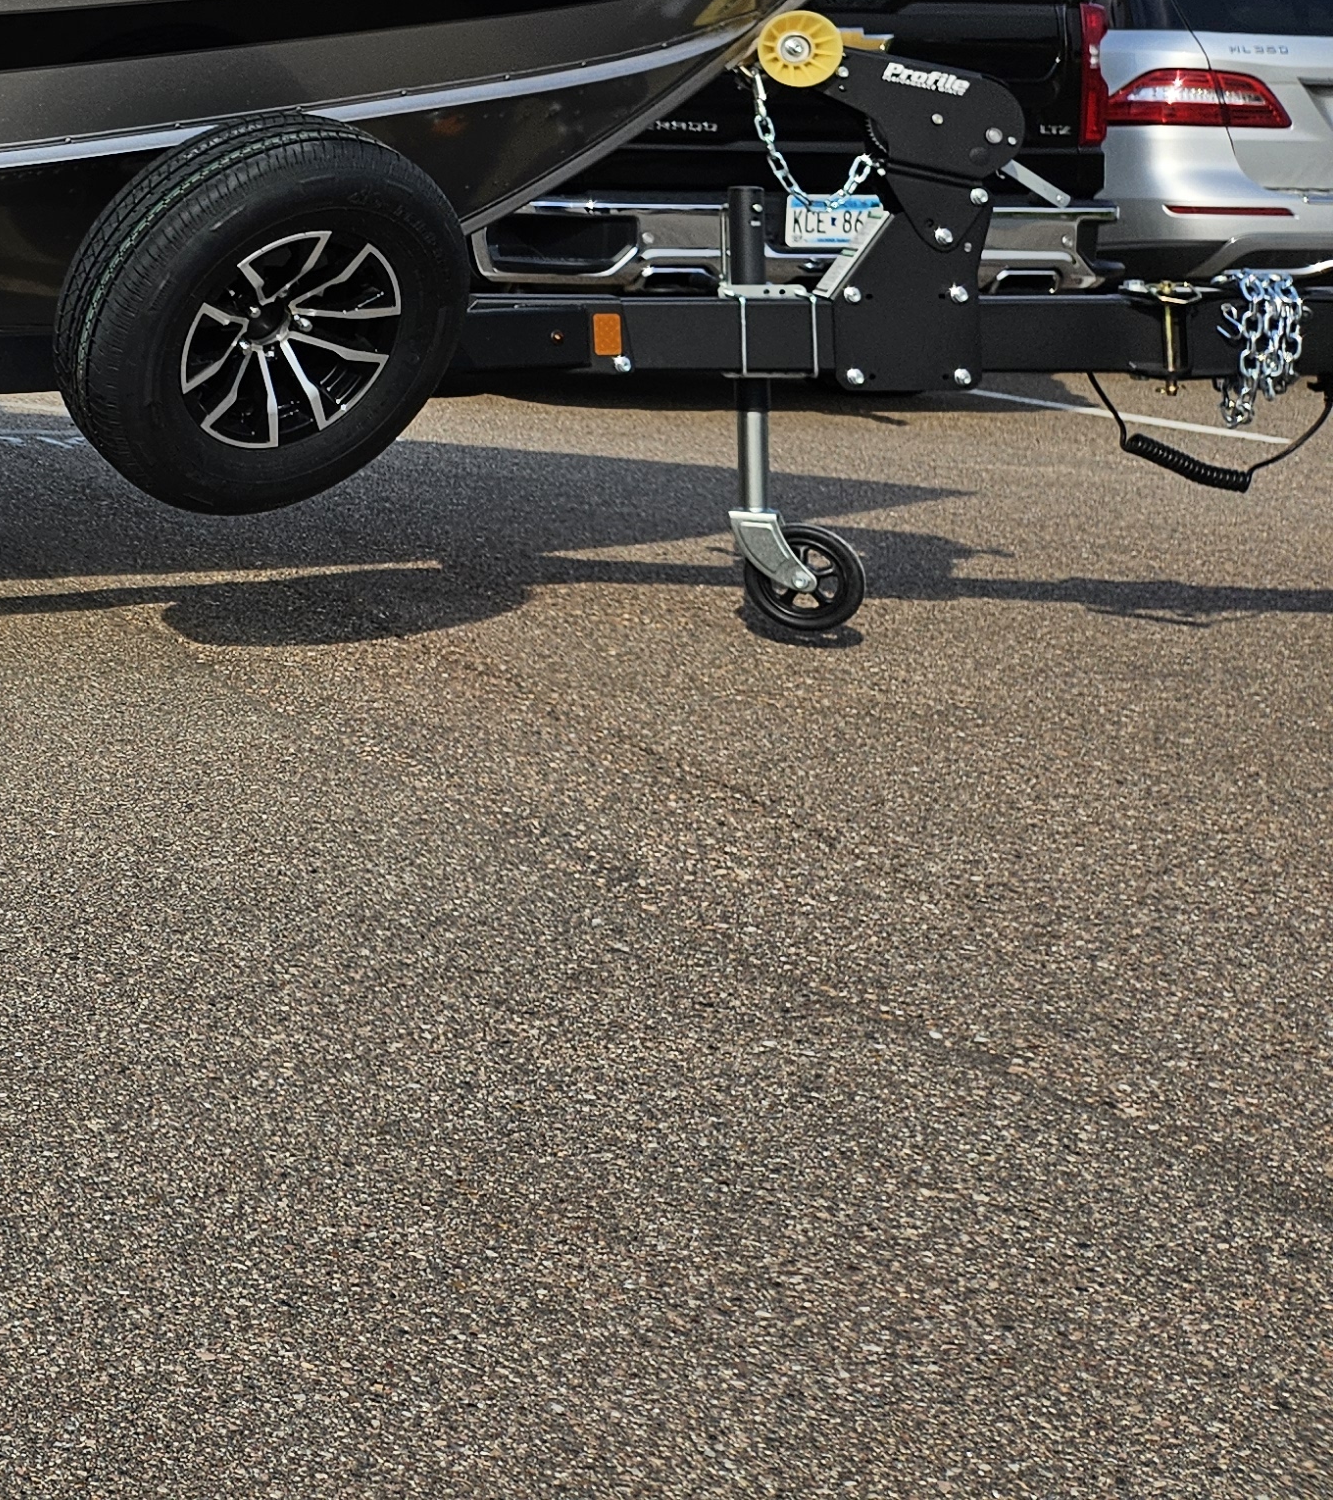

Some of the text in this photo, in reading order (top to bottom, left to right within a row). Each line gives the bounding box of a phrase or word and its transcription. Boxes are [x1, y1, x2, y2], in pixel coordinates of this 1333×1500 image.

[883, 62, 971, 92] Profile
[1039, 124, 1071, 135] LTZ
[793, 210, 864, 233] KCE 86
